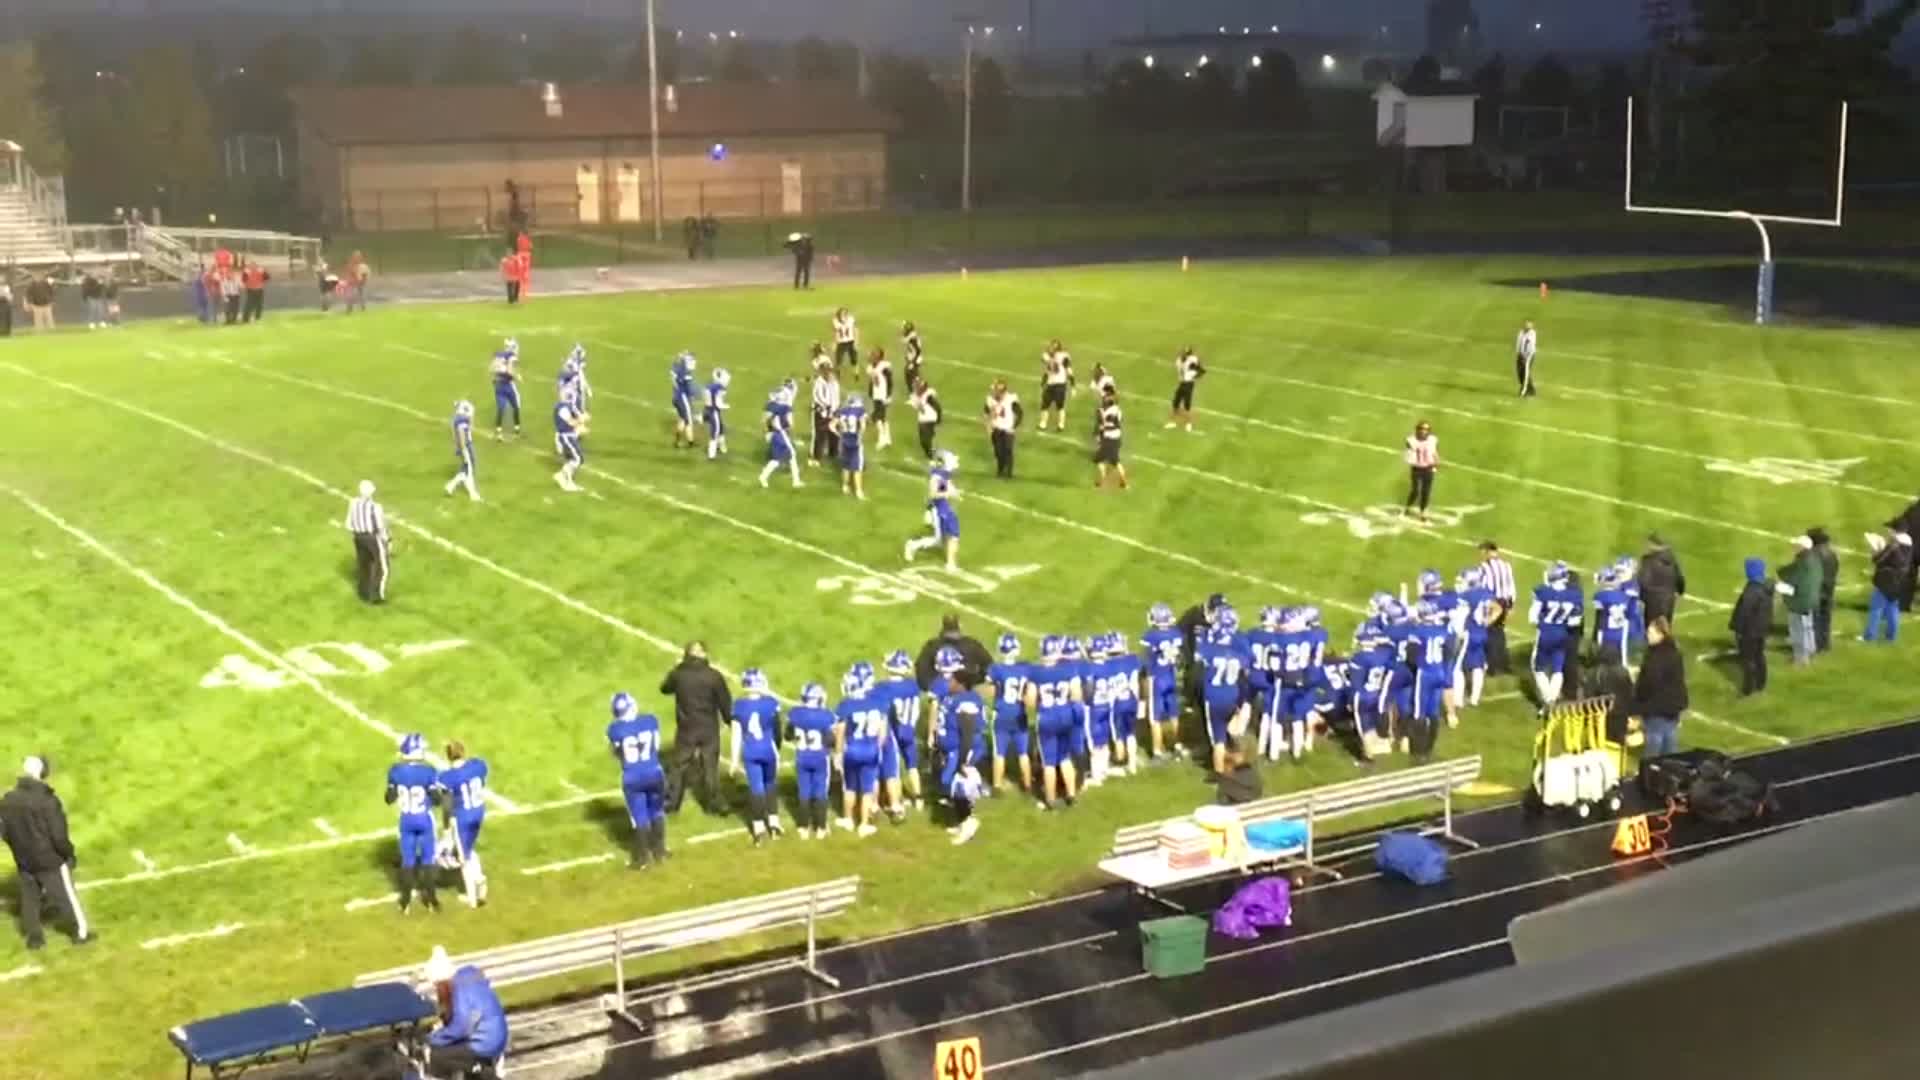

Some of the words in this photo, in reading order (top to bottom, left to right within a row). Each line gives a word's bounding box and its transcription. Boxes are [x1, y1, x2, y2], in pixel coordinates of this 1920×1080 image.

[748, 712, 763, 740] 4
[622, 731, 652, 763] 67
[1628, 821, 1647, 850] 30
[945, 1045, 977, 1080] 40
